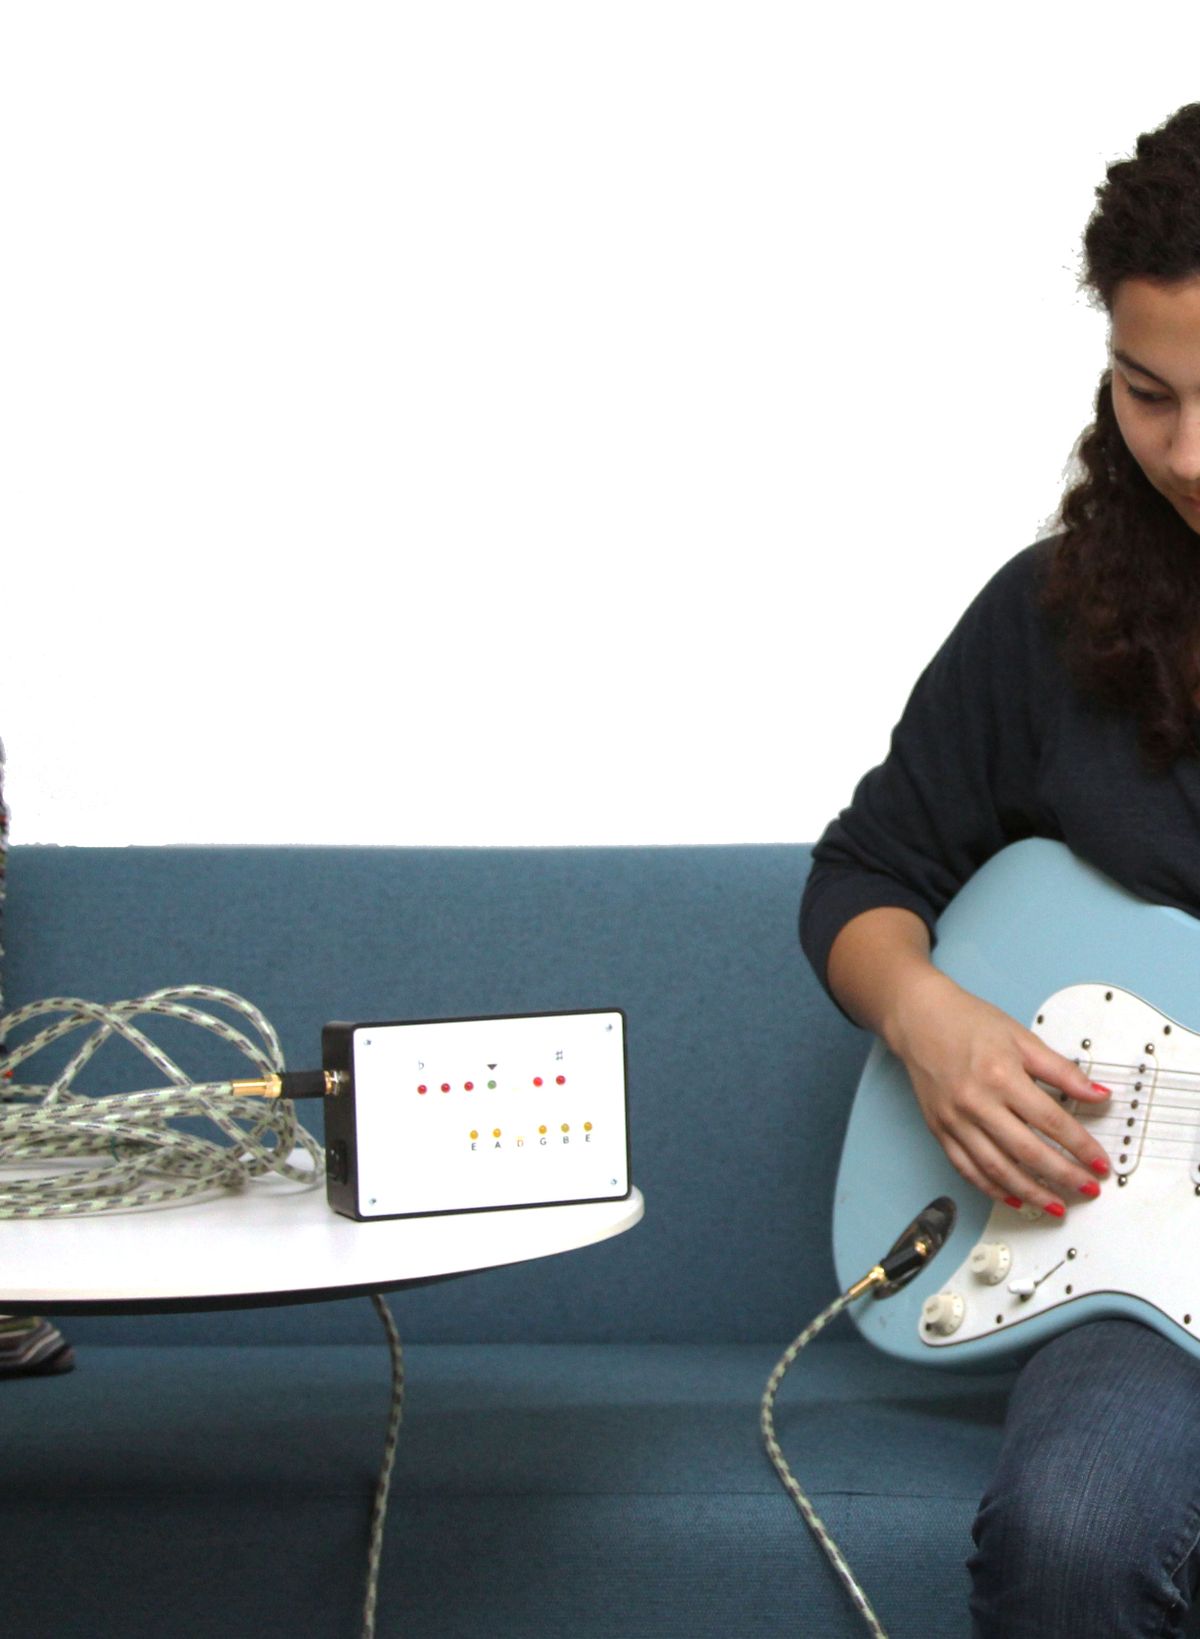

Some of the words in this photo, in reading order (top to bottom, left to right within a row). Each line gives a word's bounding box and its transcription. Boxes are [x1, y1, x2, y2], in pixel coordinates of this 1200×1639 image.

[471, 1142, 477, 1151] E
[495, 1141, 501, 1149] A
[539, 1137, 547, 1146] G
[563, 1136, 570, 1144] B
[585, 1134, 591, 1142] E
